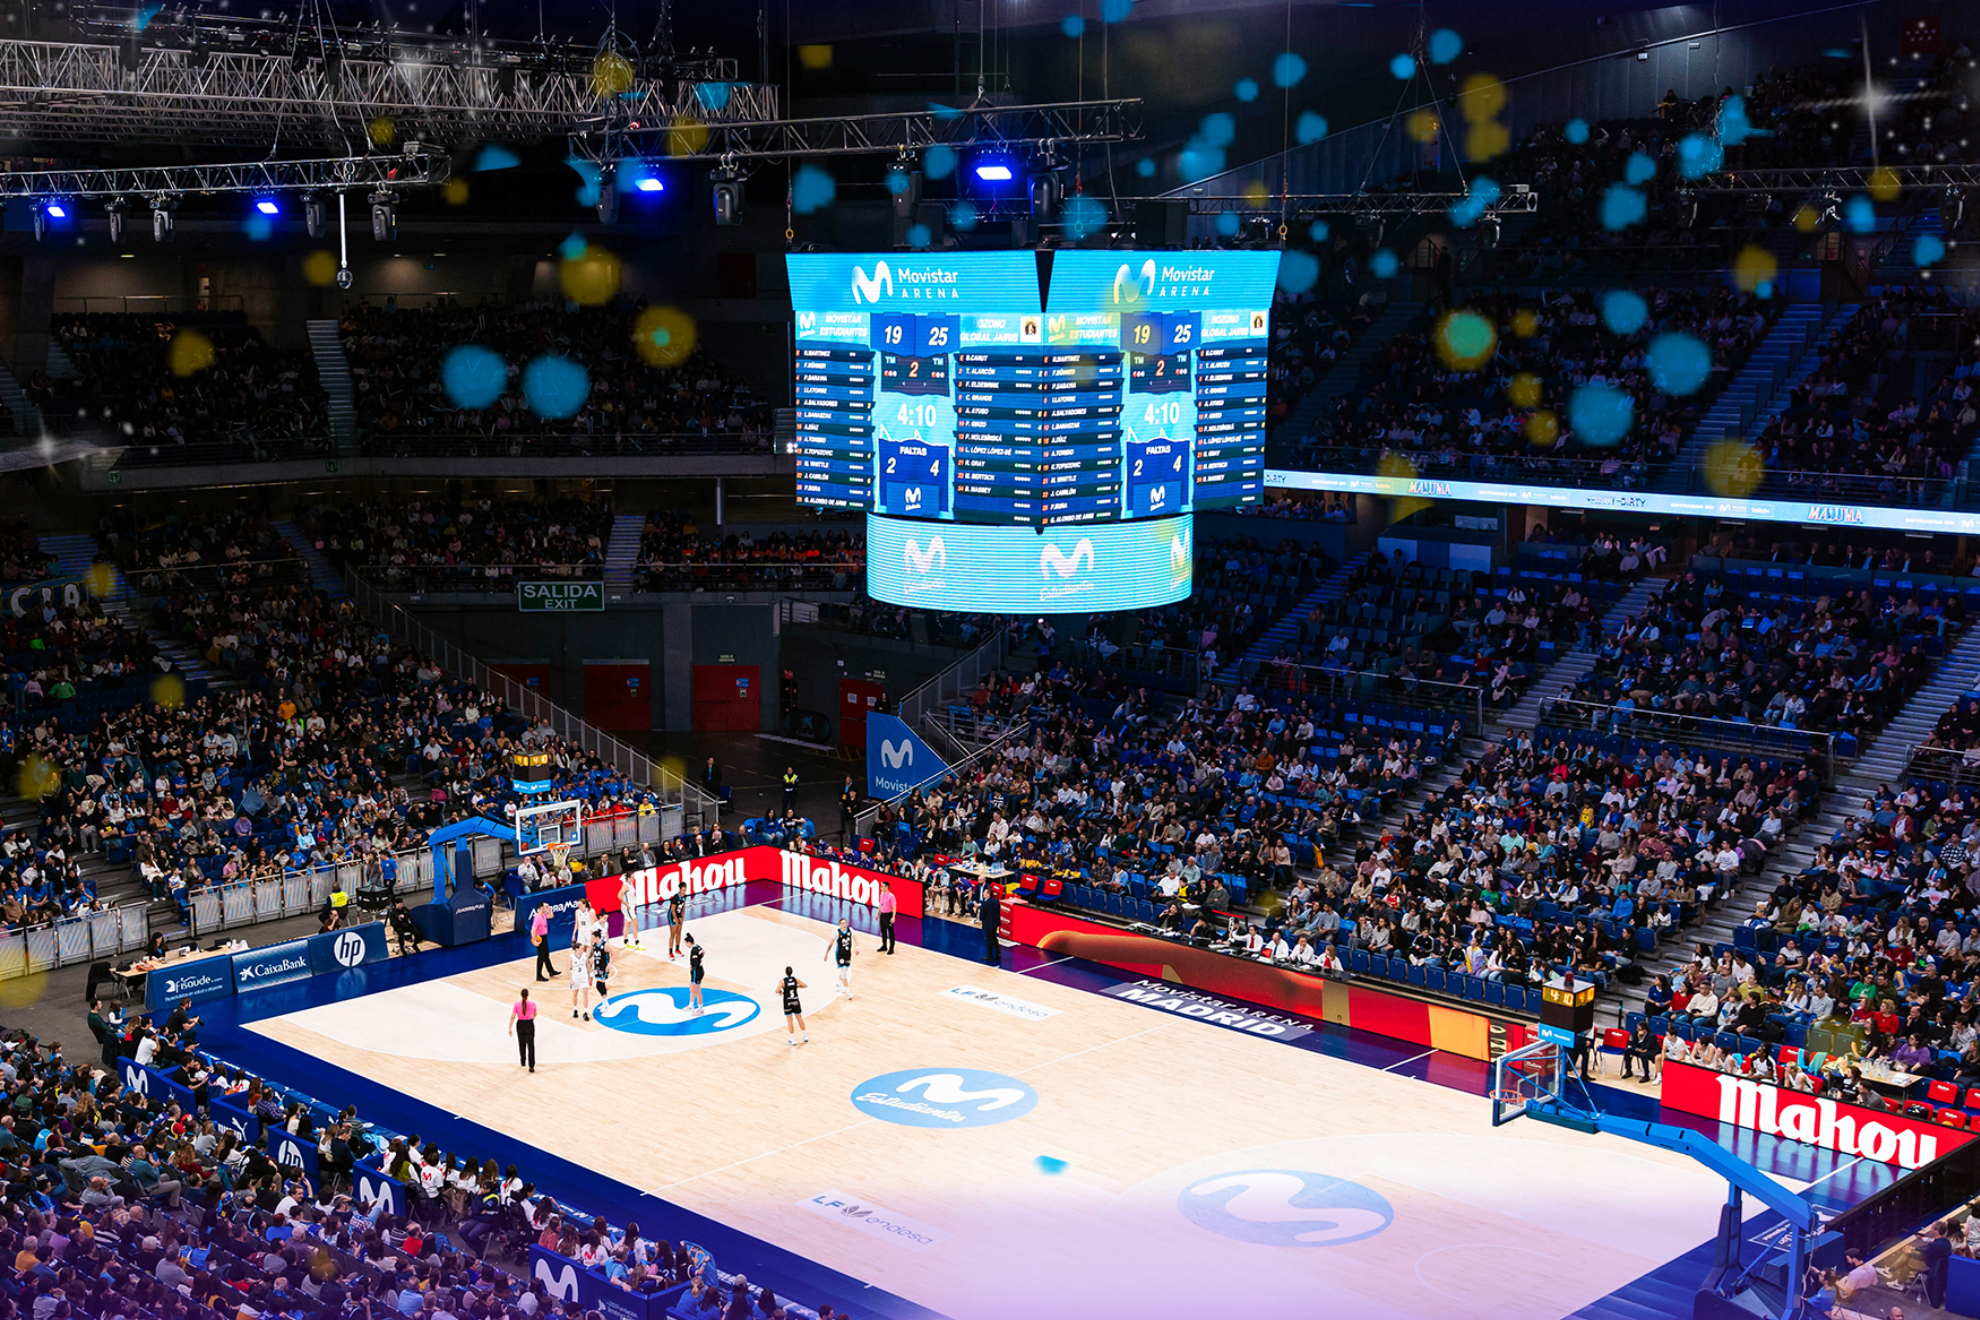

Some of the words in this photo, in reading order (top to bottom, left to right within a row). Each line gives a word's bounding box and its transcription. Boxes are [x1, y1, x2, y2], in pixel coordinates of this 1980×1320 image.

[898, 267, 958, 285] Movistar
[1161, 265, 1215, 283] Movistar
[901, 288, 959, 299] ARENA
[1159, 286, 1210, 296] ARENA
[825, 314, 862, 324] MOVISTAR
[974, 318, 1006, 329] OZONO
[1075, 315, 1113, 325] MOVISTAR
[819, 327, 867, 337] ESTUDIANTES
[884, 325, 903, 345] 19
[928, 326, 949, 346] 25
[960, 332, 992, 342] GLOBAL
[1069, 328, 1118, 339] ESTUDIANTES
[1133, 324, 1151, 345] 19
[1173, 324, 1192, 344] 25
[885, 356, 896, 364] TM
[932, 357, 944, 365] TM
[1177, 354, 1187, 363] TM
[908, 361, 919, 378] 2
[1155, 359, 1165, 377] 2
[897, 403, 936, 427] 4:10
[1144, 402, 1180, 425] 4:10
[900, 446, 928, 456] FALTAS
[1146, 445, 1172, 455] FALTAS
[886, 457, 897, 474] 2
[930, 459, 940, 477] 4
[1133, 459, 1143, 477] 2
[1173, 455, 1182, 472] 4
[1408, 480, 1451, 496] MALUMA
[1808, 506, 1864, 523] MALUMA
[0, 582, 81, 619] CIA
[523, 585, 598, 598] SALIDA
[544, 599, 577, 609] EXIT
[875, 776, 916, 794] Movist
[338, 932, 361, 966] hp
[254, 956, 306, 977] CaixaBank
[949, 986, 975, 999] LF
[994, 996, 1048, 1018] endesa
[1132, 978, 1230, 1014] Movistar
[1228, 1006, 1314, 1031] ARENA
[1115, 987, 1288, 1036] MADRID
[855, 1092, 967, 1123] Estudiantes
[1715, 1073, 1938, 1171] Mahou
[812, 1195, 845, 1209] LF
[865, 1215, 933, 1245] endesa
